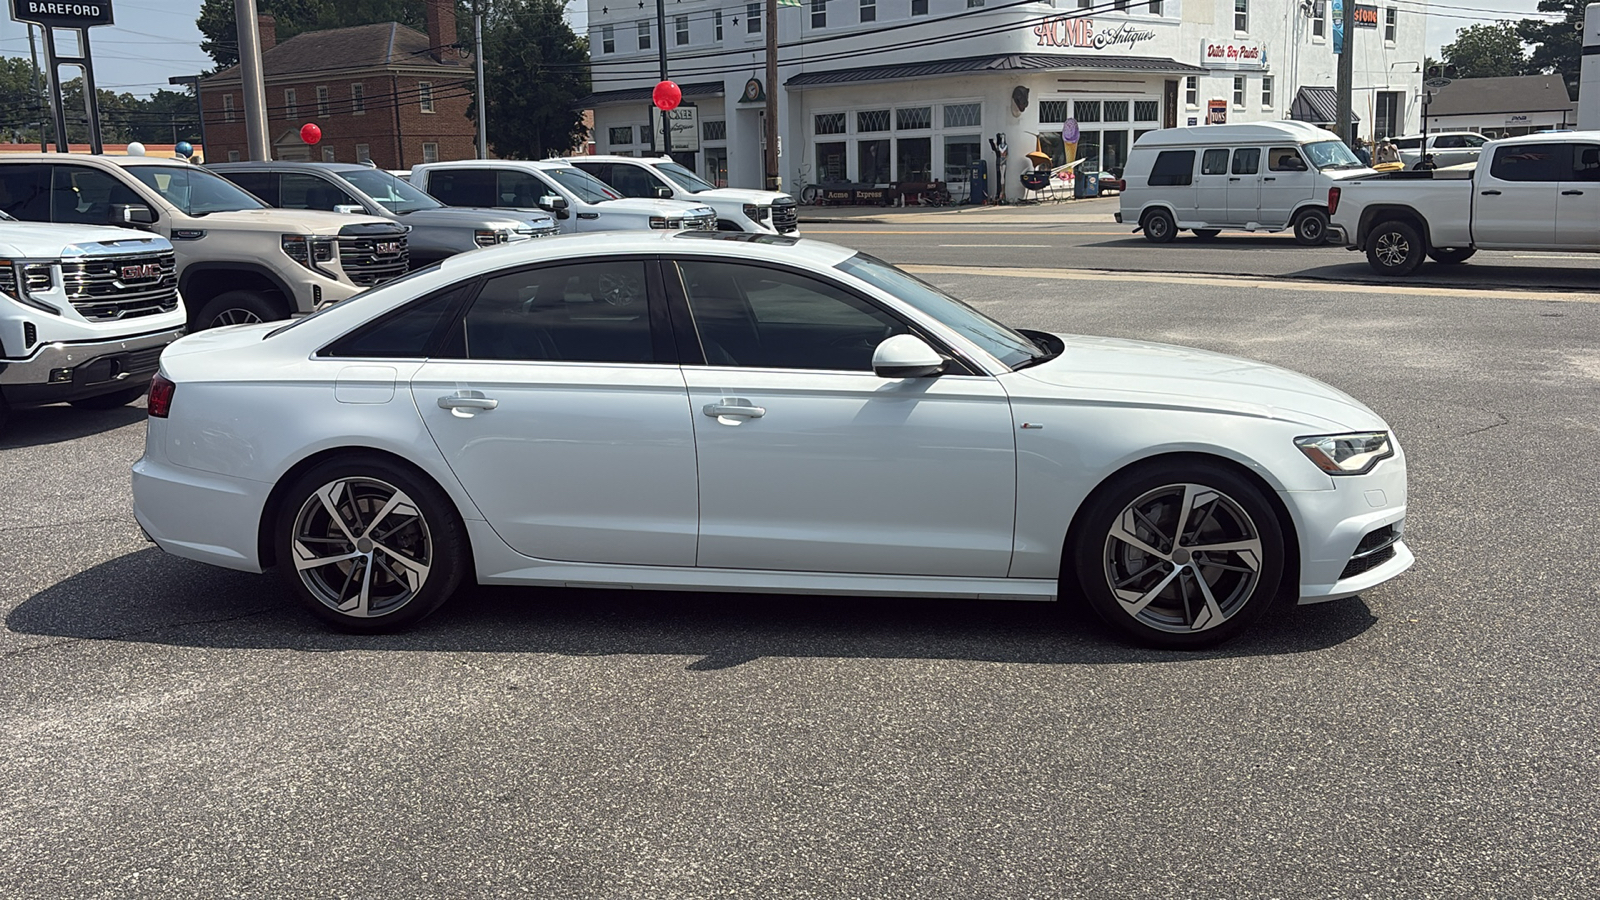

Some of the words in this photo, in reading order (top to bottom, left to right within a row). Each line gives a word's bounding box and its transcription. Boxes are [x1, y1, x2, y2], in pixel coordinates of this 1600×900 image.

[28, 1, 100, 17] BAREFORD
[1033, 16, 1094, 49] ACME
[1093, 21, 1157, 50] Antiques
[1207, 44, 1225, 58] Dutch
[1226, 45, 1239, 61] Boy
[1239, 45, 1259, 59] Paints
[828, 191, 849, 199] Acme
[856, 191, 882, 200] Express
[121, 263, 161, 280] GMC
